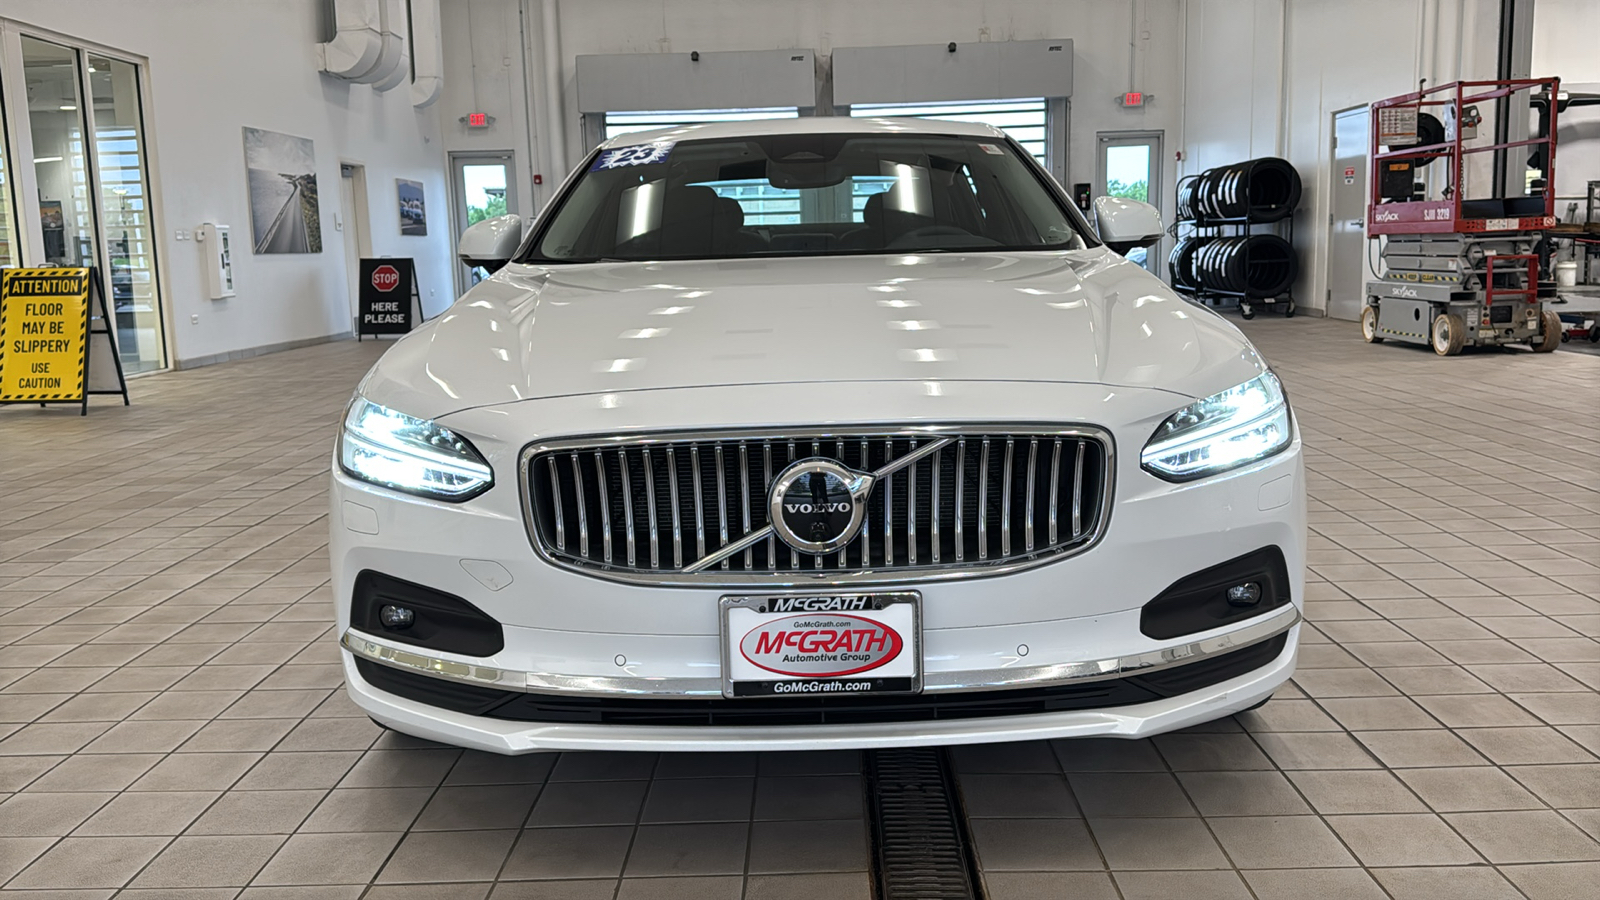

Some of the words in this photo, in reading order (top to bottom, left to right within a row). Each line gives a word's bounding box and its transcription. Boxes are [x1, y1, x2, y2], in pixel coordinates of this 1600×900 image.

[1126, 92, 1142, 105] EXIT
[470, 113, 485, 125] EXIT
[613, 147, 656, 163] 23
[1376, 210, 1399, 222] SKYJACK
[374, 273, 397, 284] STOP
[12, 280, 78, 293] ATTENTION
[1392, 286, 1417, 297] SKYJACK
[25, 303, 63, 316] FLOOR
[371, 302, 399, 311] HERE
[364, 314, 405, 324] PLEASE
[22, 322, 45, 334] MAY
[49, 321, 64, 334] BE
[14, 340, 70, 353] SLIPPERY
[31, 363, 50, 373] USE
[19, 378, 61, 388] CAUTION
[784, 502, 850, 513] VOLVO
[782, 653, 838, 663] Automotive
[840, 653, 870, 662] Group
[774, 681, 871, 693] GoMcGrath.com
